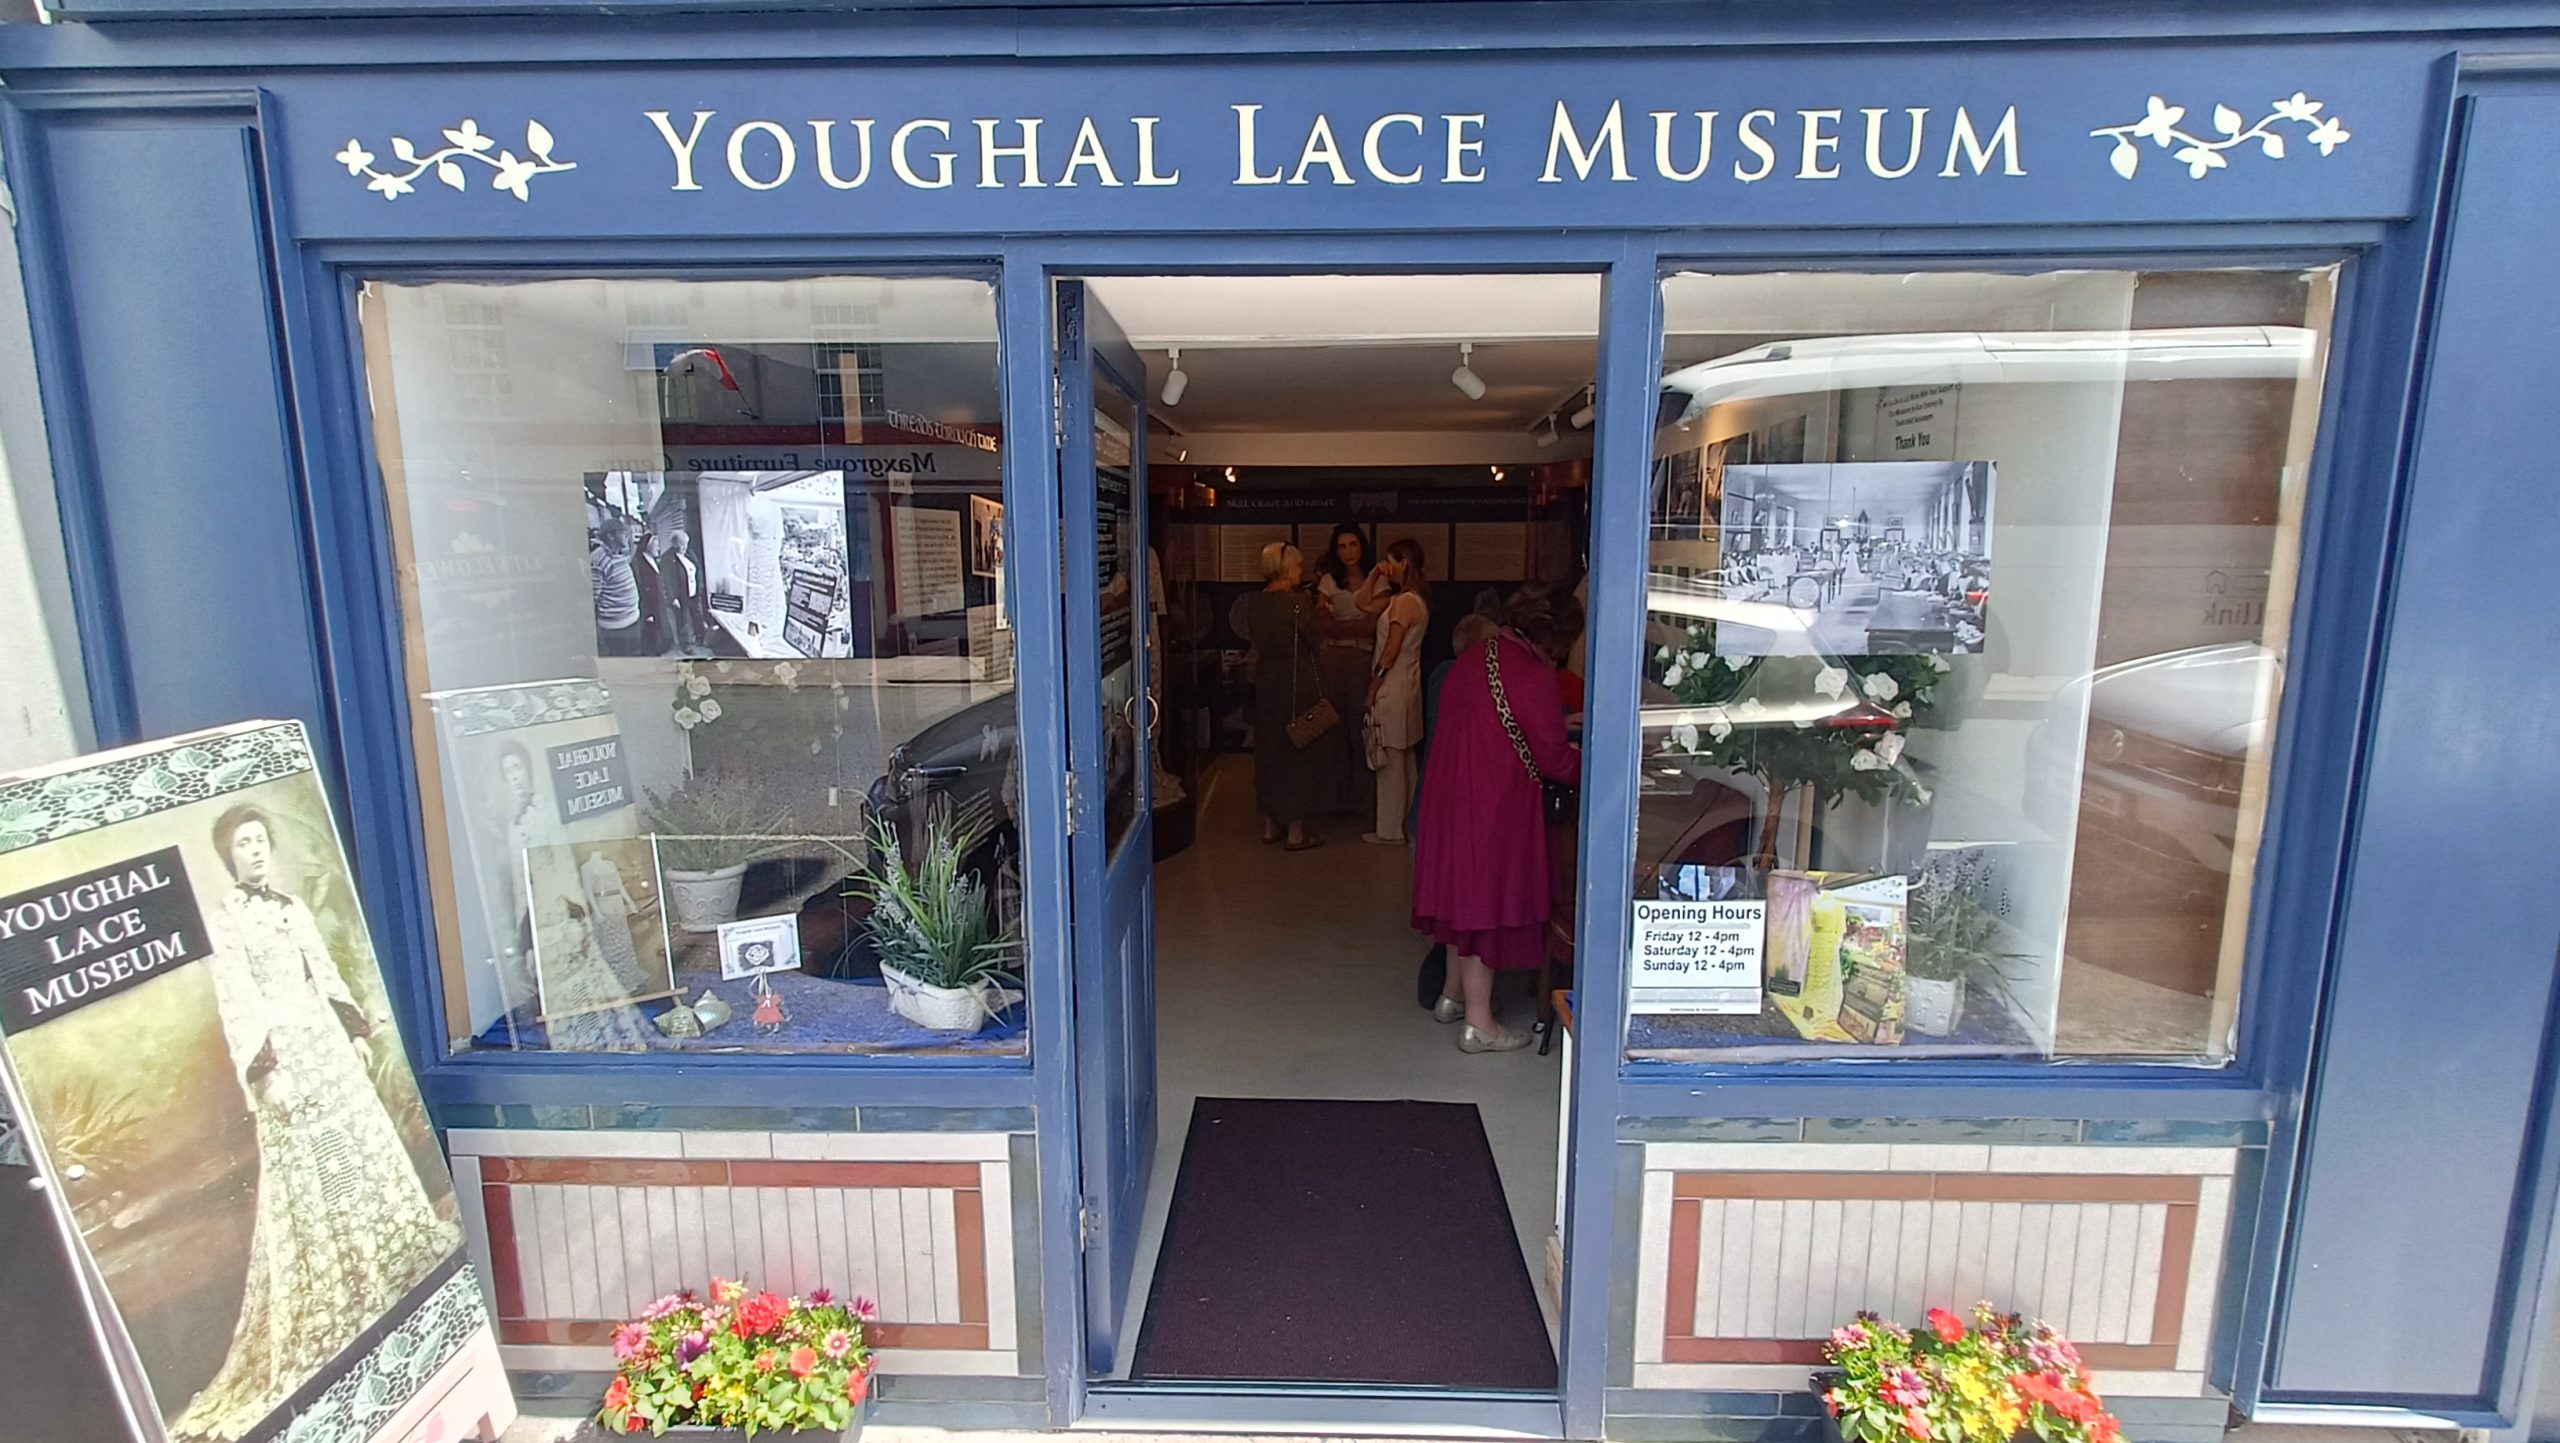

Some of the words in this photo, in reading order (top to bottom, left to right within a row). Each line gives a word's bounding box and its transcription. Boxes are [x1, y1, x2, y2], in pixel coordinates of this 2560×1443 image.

[644, 110, 1181, 192] YOUGHAL
[1229, 102, 1488, 185] LACE
[1537, 97, 2028, 184] MUSEUM
[1895, 434, 1915, 450] Thank
[1918, 432, 1931, 447] You
[0, 864, 171, 939] YOUGHAL
[1638, 905, 1707, 923] Opening
[1712, 905, 1761, 920] Hours
[44, 908, 147, 964] LACE
[1645, 931, 1684, 943] Friday
[1688, 931, 1702, 941] 12
[1713, 931, 1740, 943] 4pm
[1644, 945, 1699, 958] Saturday
[1703, 945, 1717, 956] 12
[1728, 945, 1755, 957] 4pm
[22, 931, 187, 1015] MUSEUM
[1643, 960, 1690, 973] Sunday
[1694, 960, 1708, 971] 12
[1718, 960, 1745, 973] 4pm
